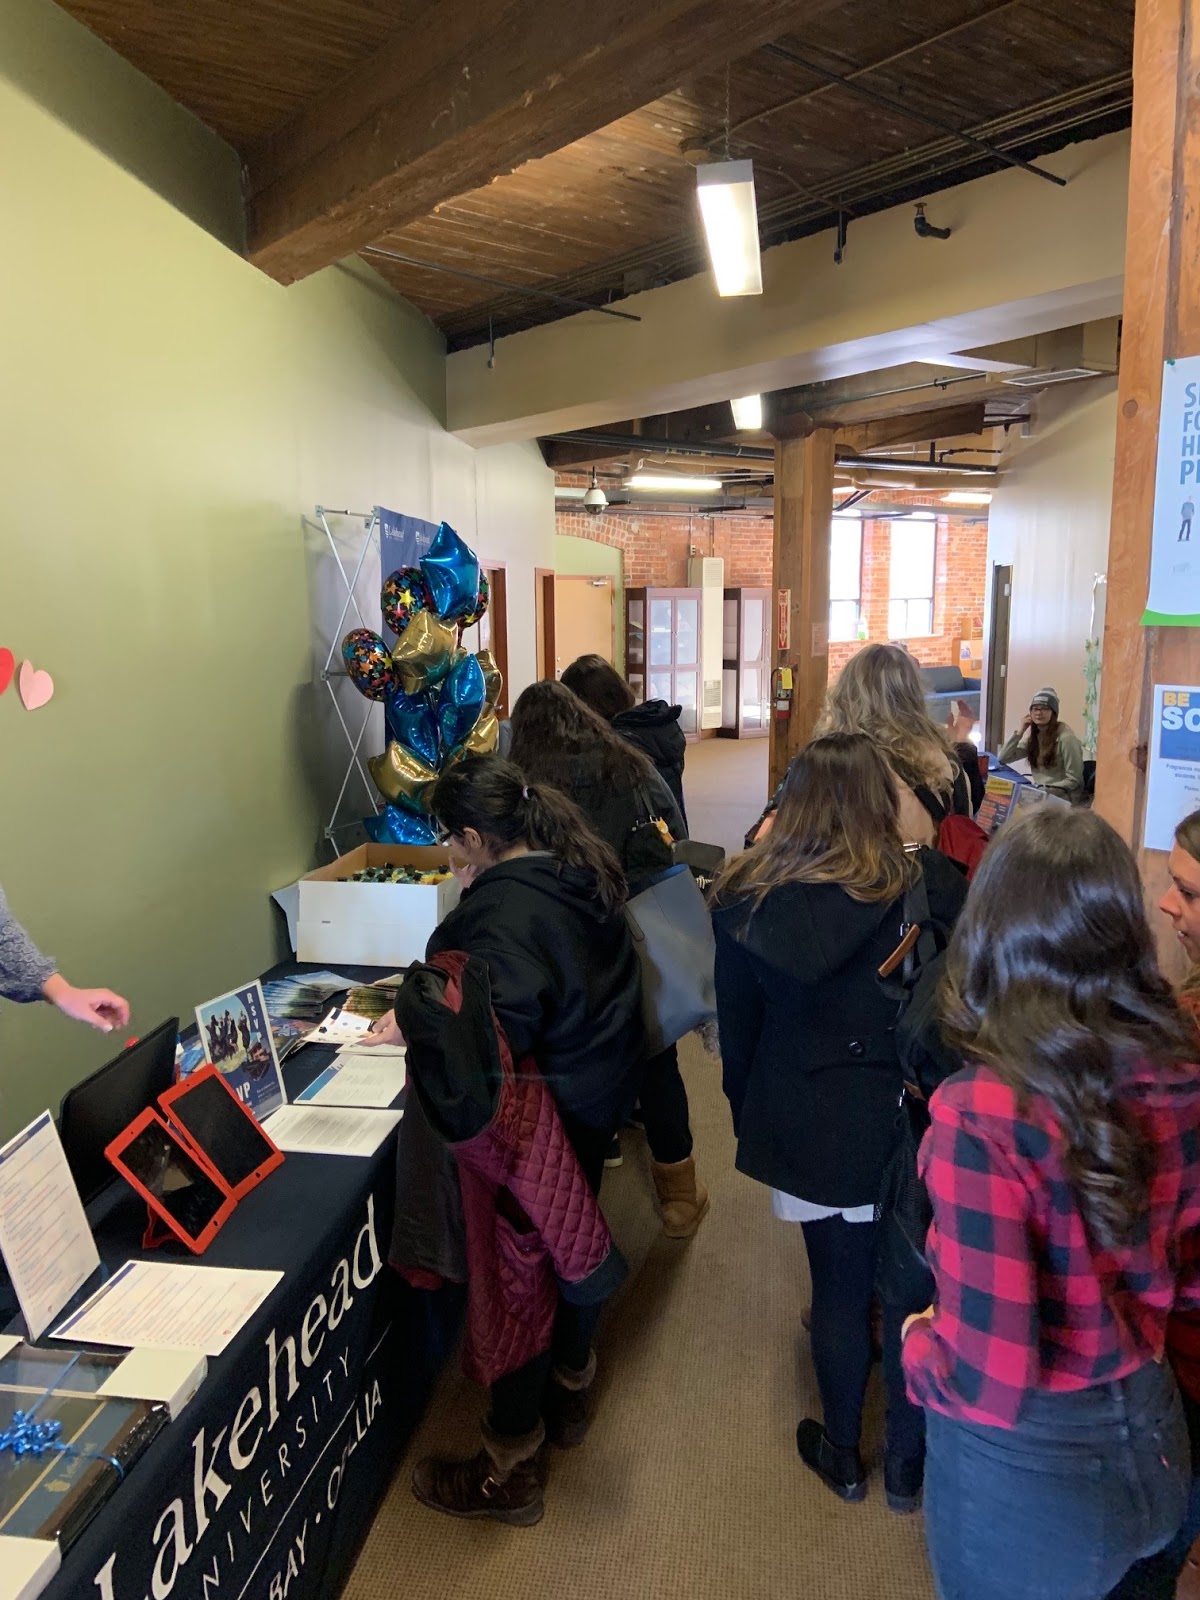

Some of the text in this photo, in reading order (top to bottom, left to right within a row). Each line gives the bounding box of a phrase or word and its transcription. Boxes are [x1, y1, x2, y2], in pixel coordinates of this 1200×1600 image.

[1184, 382, 1200, 408] S
[1181, 434, 1200, 457] H
[1180, 459, 1200, 485] P
[1163, 692, 1190, 707] BE
[269, 1379, 382, 1600] BAY OLLIA
